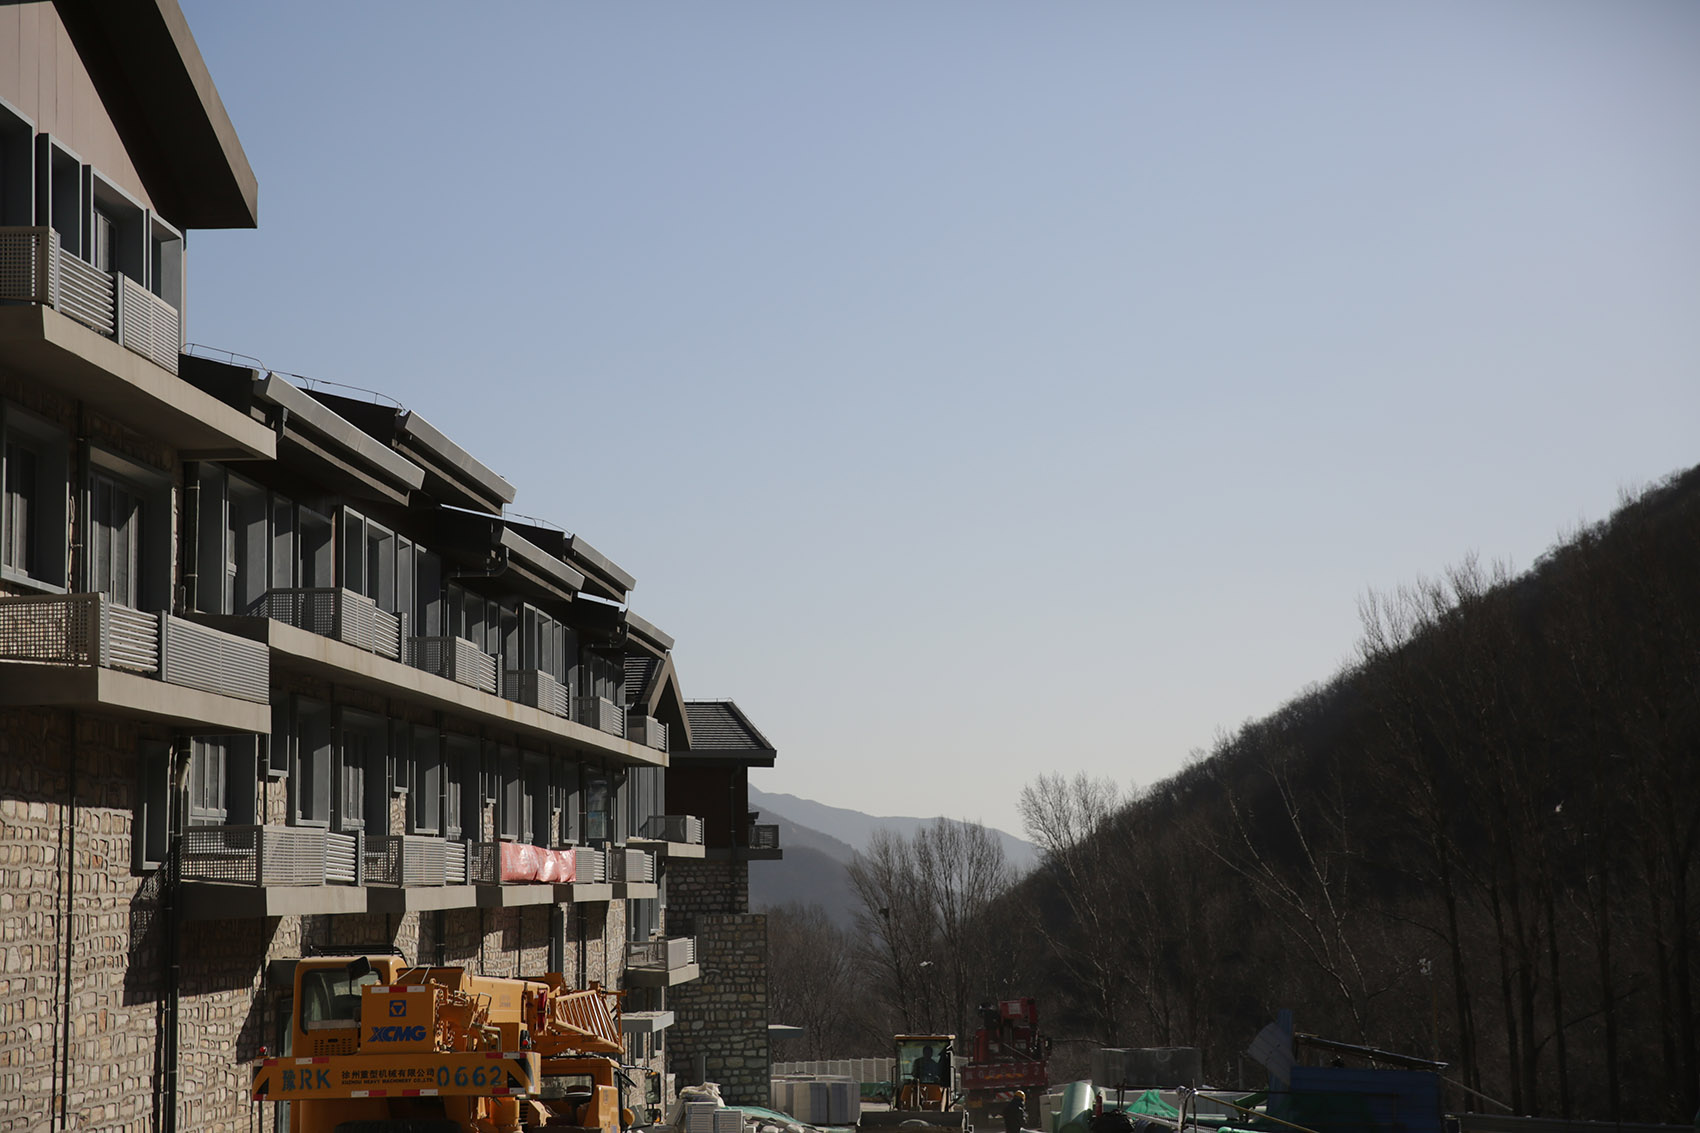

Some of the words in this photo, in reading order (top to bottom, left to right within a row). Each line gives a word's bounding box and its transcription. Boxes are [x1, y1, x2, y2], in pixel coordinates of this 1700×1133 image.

[368, 1025, 427, 1042] XCMG
[342, 1068, 435, 1079] 徐州重型机械有限公司
[437, 1066, 502, 1087] 0662
